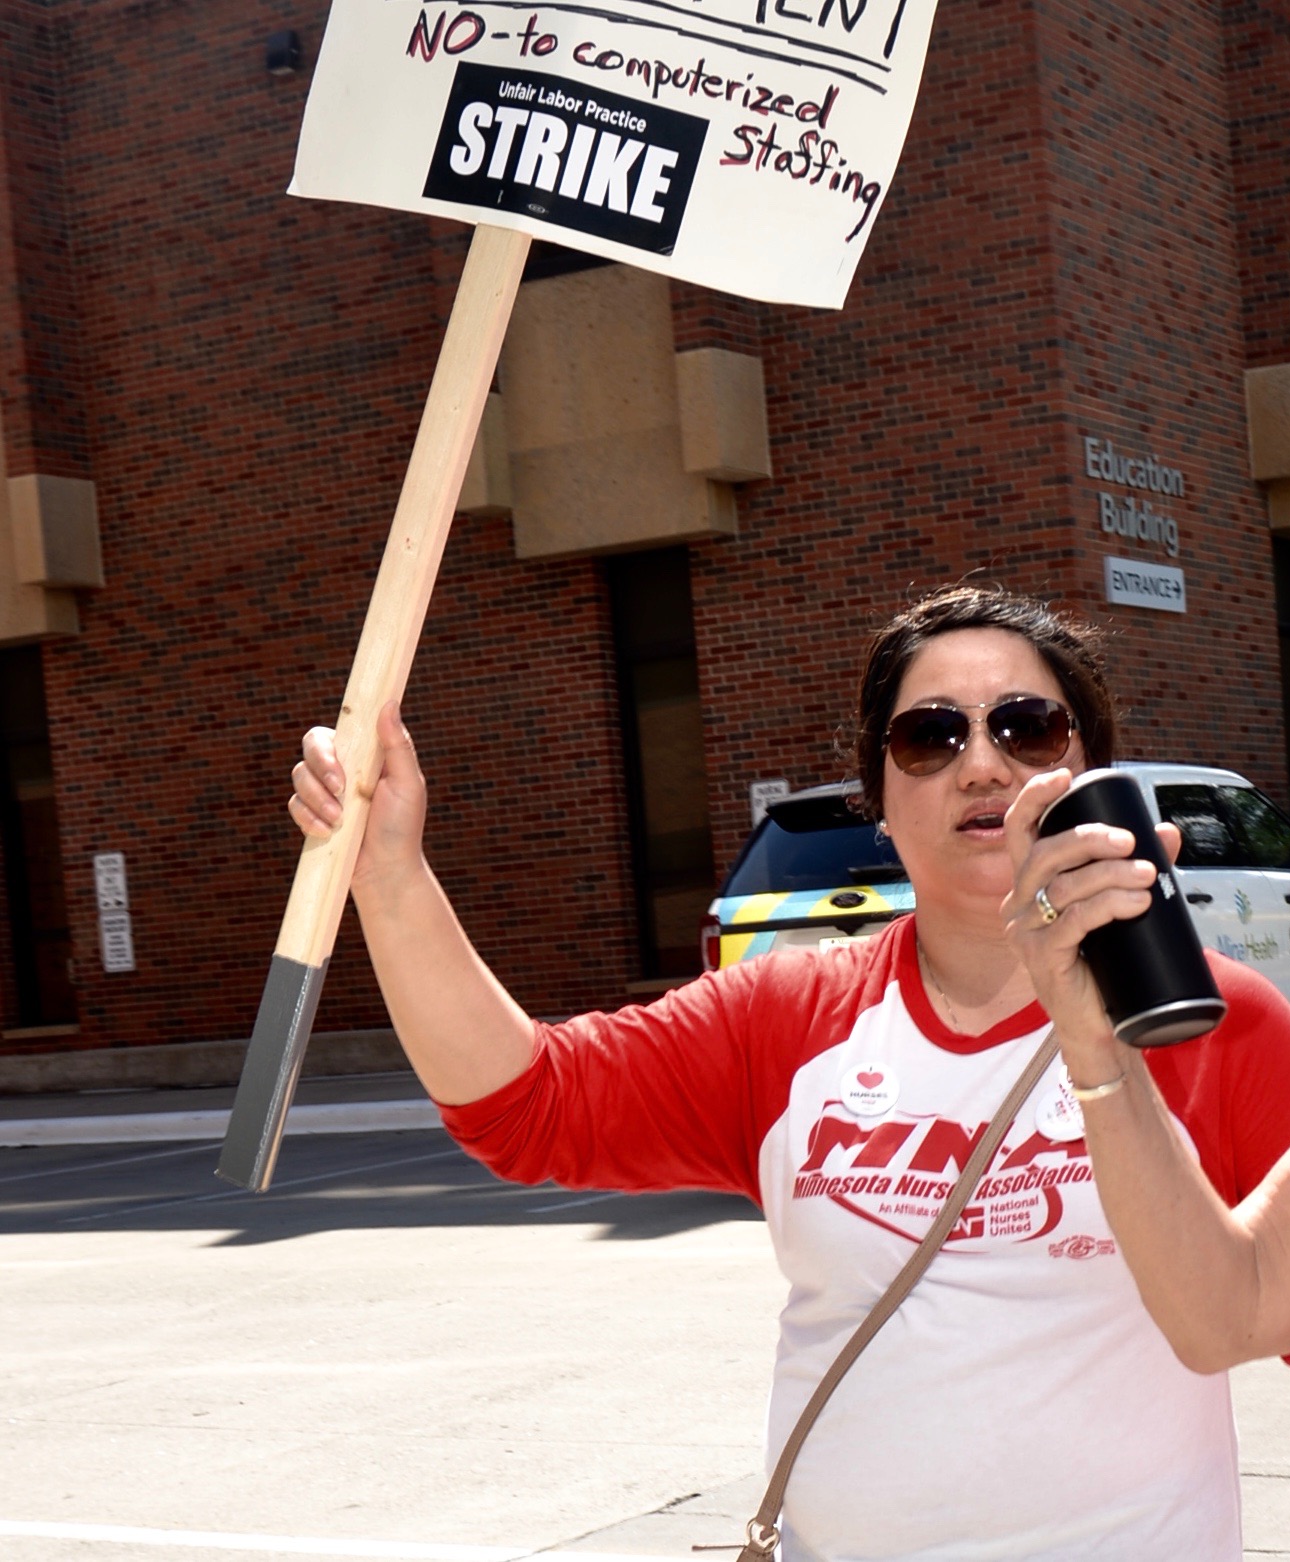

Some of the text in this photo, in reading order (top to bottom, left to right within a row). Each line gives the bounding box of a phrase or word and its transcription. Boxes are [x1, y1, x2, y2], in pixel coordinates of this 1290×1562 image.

[573, 42, 839, 129] computerized
[498, 80, 647, 133] Unfair Labor Practice
[450, 101, 680, 224] STRIKE
[720, 122, 881, 243] Staffing
[1085, 437, 1185, 498] Education
[1100, 492, 1178, 558] Building
[1112, 570, 1171, 599] ENTRANCE
[792, 1172, 893, 1200] Minnesota
[894, 1174, 957, 1200] Nurs
[990, 1195, 1039, 1214] National
[879, 1201, 892, 1214] An
[894, 1203, 929, 1217] Affiliate
[990, 1210, 1031, 1226] Nurses
[990, 1220, 1032, 1237] United
